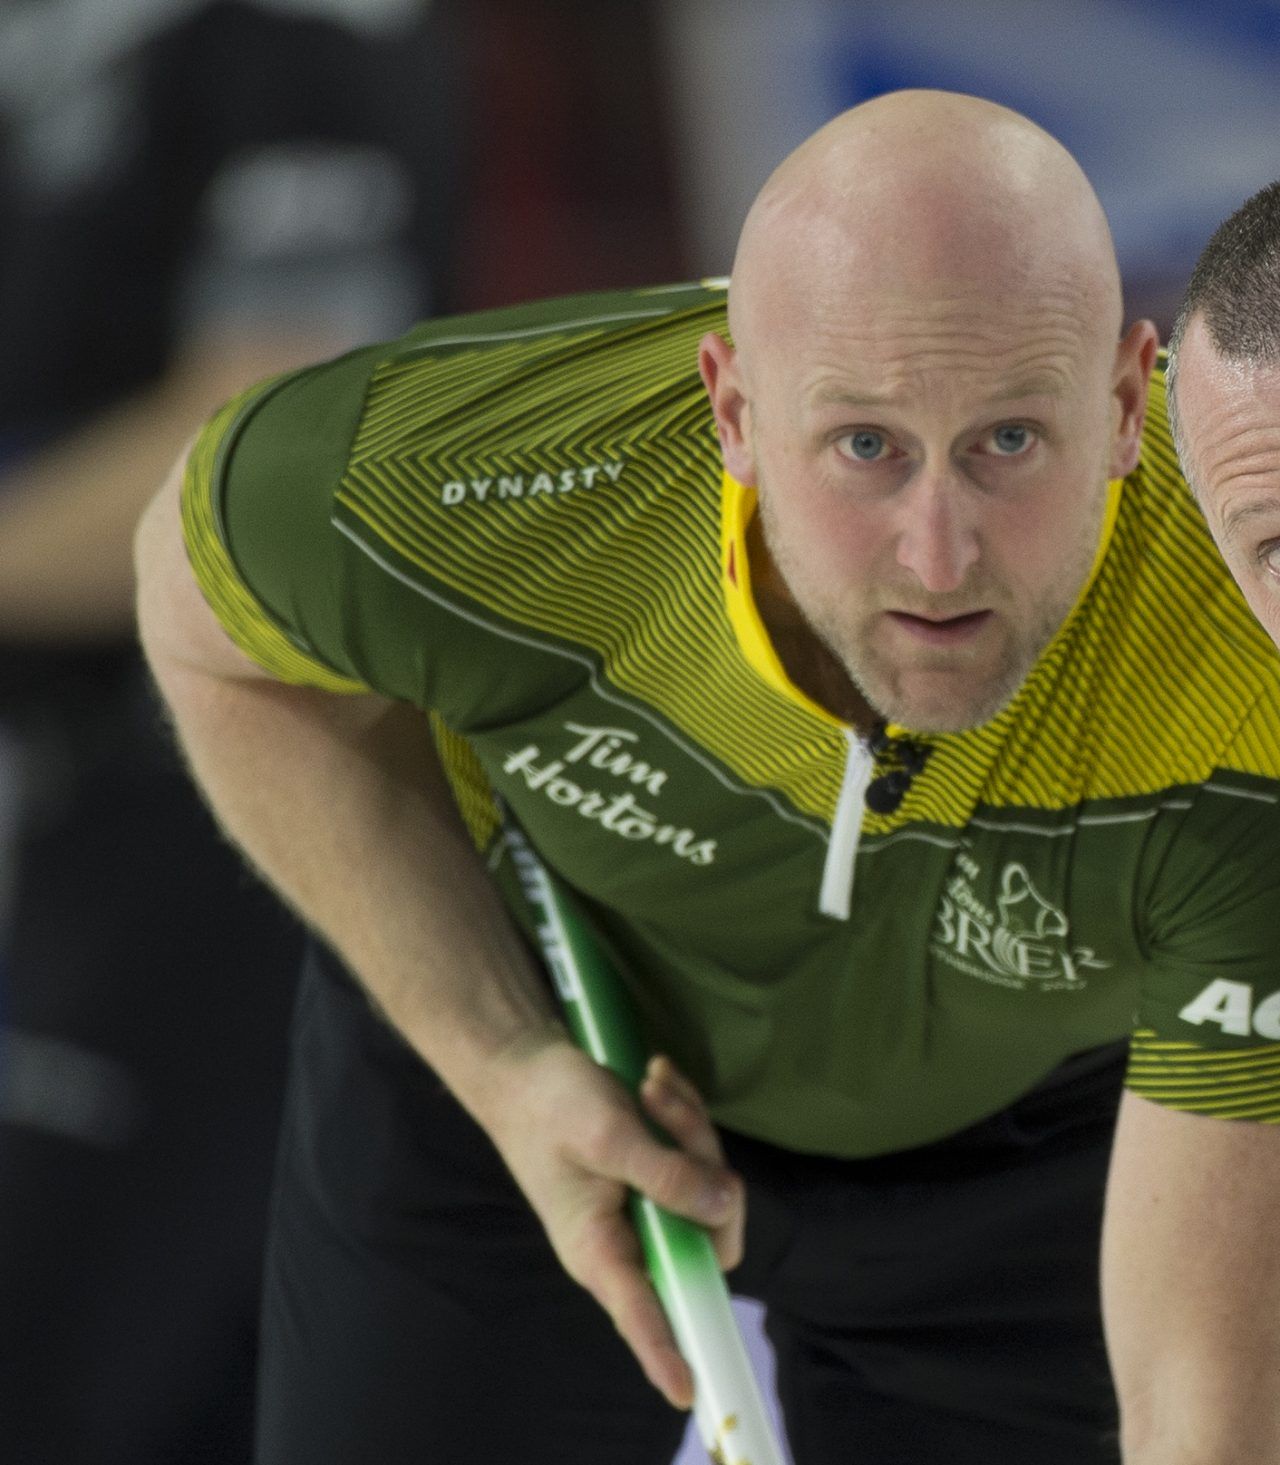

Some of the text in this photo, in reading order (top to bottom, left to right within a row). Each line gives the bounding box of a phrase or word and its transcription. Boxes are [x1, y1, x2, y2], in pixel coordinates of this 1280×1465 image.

[442, 462, 625, 505] DYNASTY
[564, 721, 668, 796] Tim
[504, 744, 719, 866] Hortons
